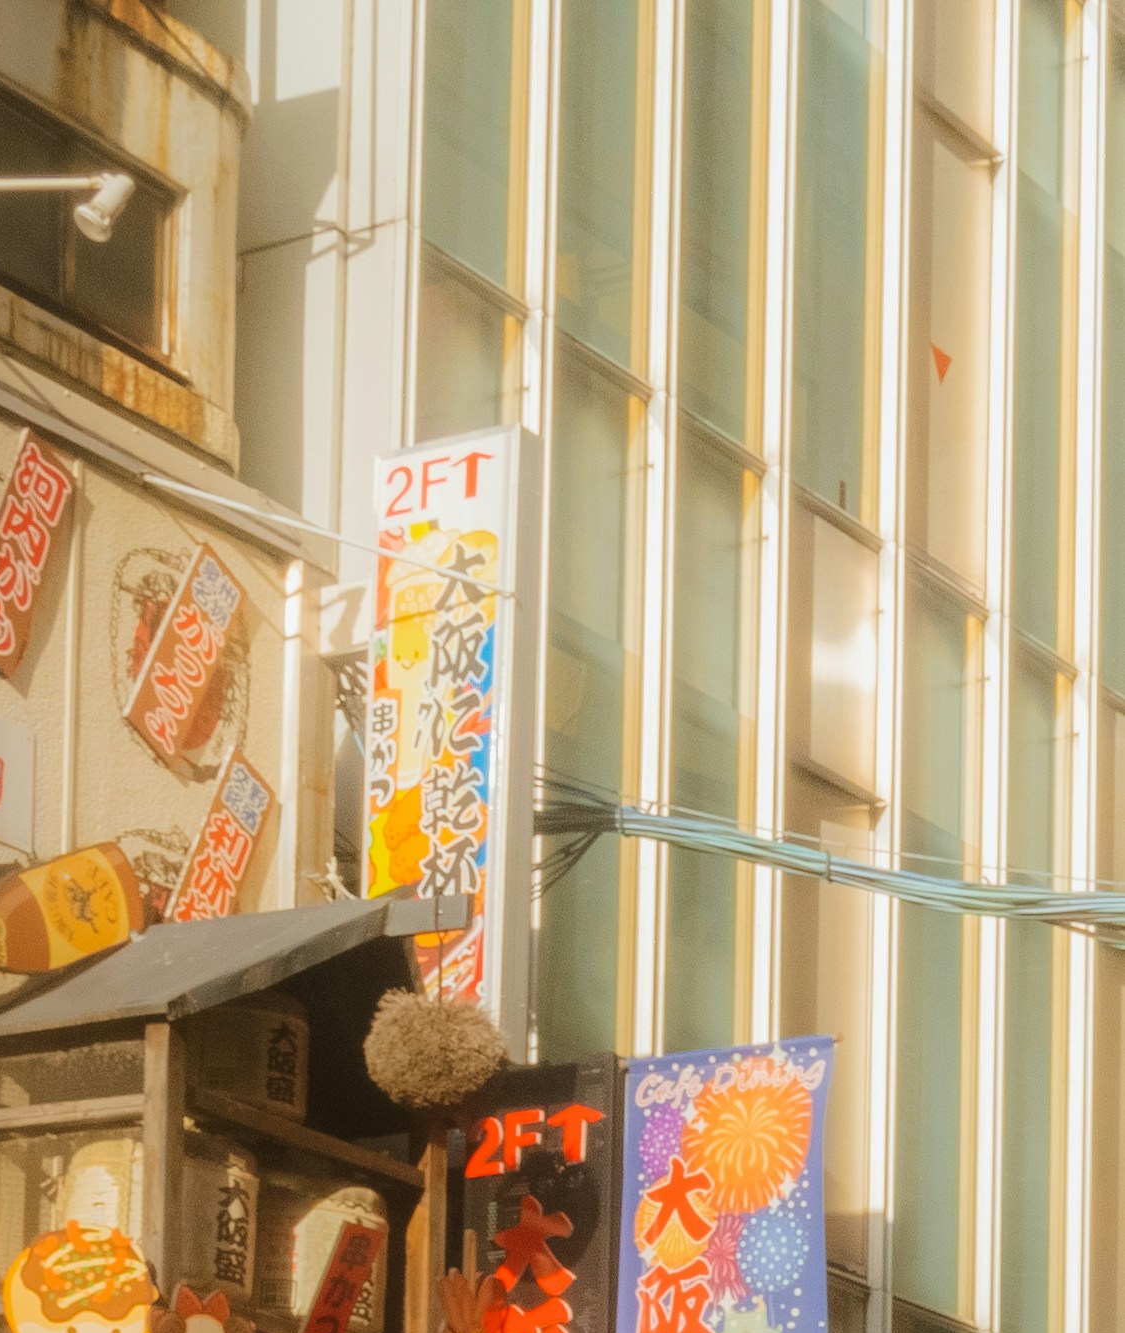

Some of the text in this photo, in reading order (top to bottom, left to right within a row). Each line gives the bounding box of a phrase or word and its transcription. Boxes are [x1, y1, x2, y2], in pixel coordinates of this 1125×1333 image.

[416, 541, 493, 898] 大阪に乾杯
[634, 1058, 827, 1109] Cafe Dining
